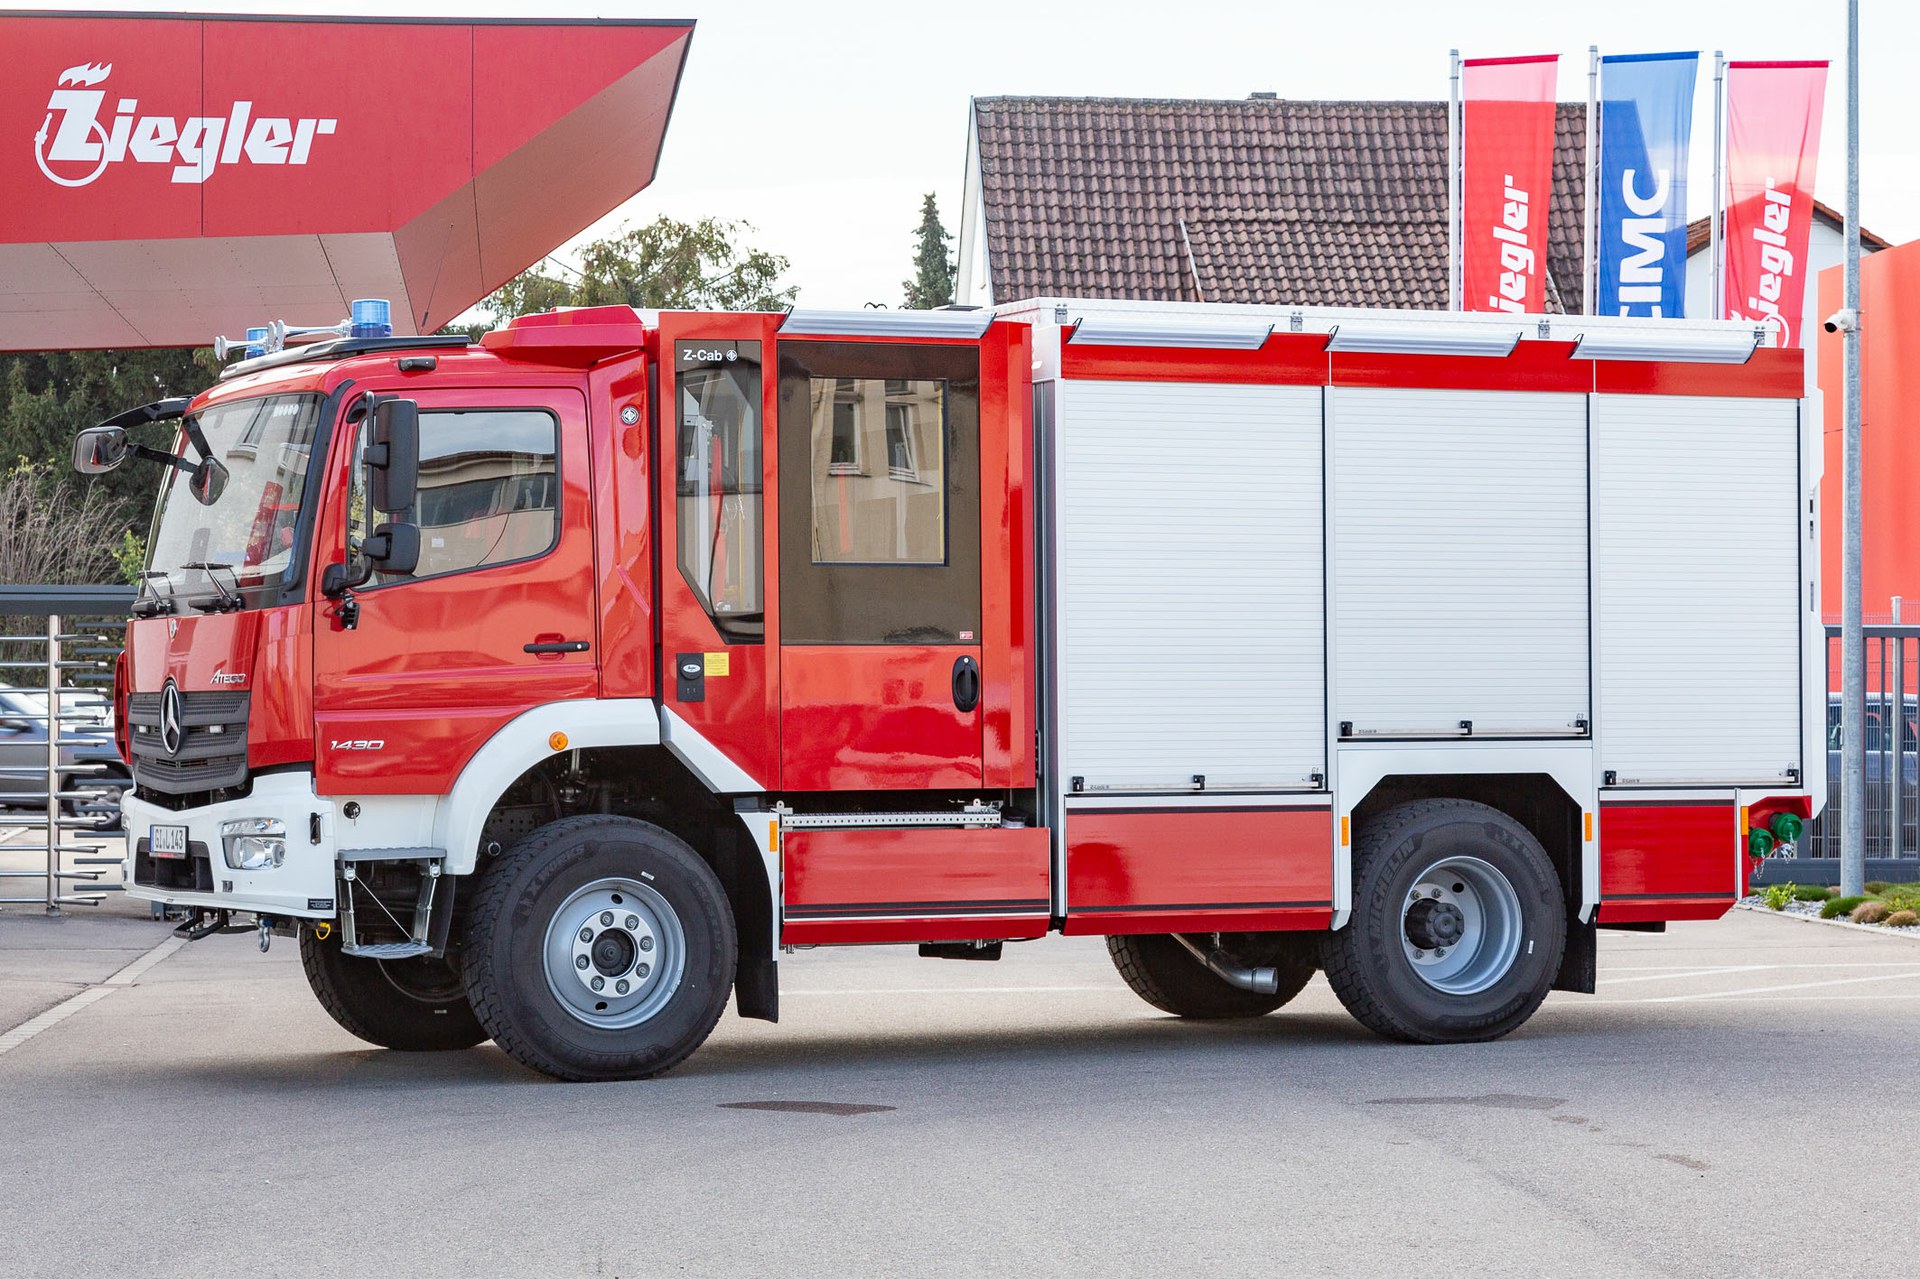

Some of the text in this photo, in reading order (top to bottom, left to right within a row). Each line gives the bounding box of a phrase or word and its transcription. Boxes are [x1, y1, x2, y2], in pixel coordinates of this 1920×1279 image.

[34, 88, 338, 187] Ziegler
[1489, 174, 1535, 314] iegler
[1618, 168, 1670, 319] IMC
[1748, 176, 1794, 318] iegler
[682, 348, 723, 361] Z-Cab
[330, 740, 385, 750] 1430
[1368, 834, 1416, 940] MICHELIN
